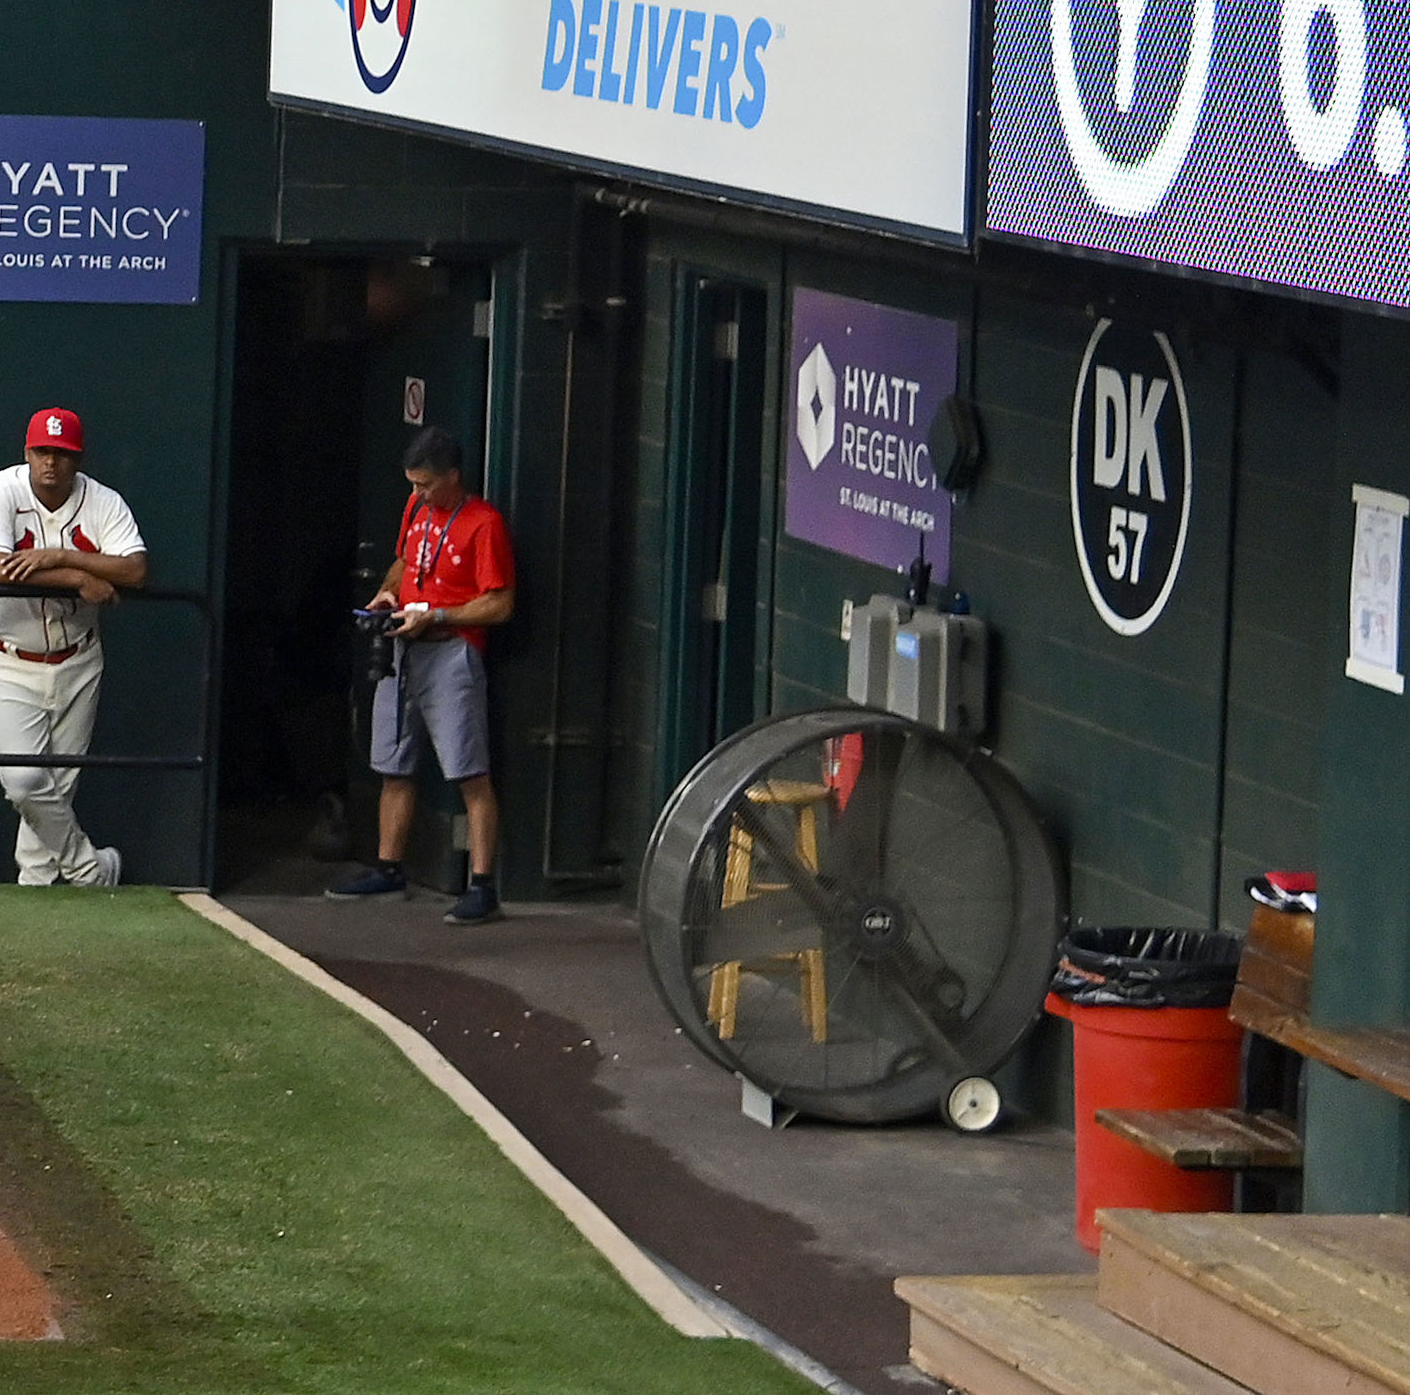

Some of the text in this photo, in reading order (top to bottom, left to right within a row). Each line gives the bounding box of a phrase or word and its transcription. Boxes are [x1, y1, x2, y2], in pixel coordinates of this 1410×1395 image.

[52, 254, 75, 269] AT
[79, 255, 114, 270] THE
[118, 255, 167, 271] ARCH
[843, 365, 920, 427] HYATT
[841, 421, 938, 491] REGENC
[1092, 364, 1169, 504] DK
[853, 491, 878, 516] LOUIS
[880, 496, 891, 517] AT
[892, 501, 909, 526] THE
[1107, 505, 1149, 586] 57
